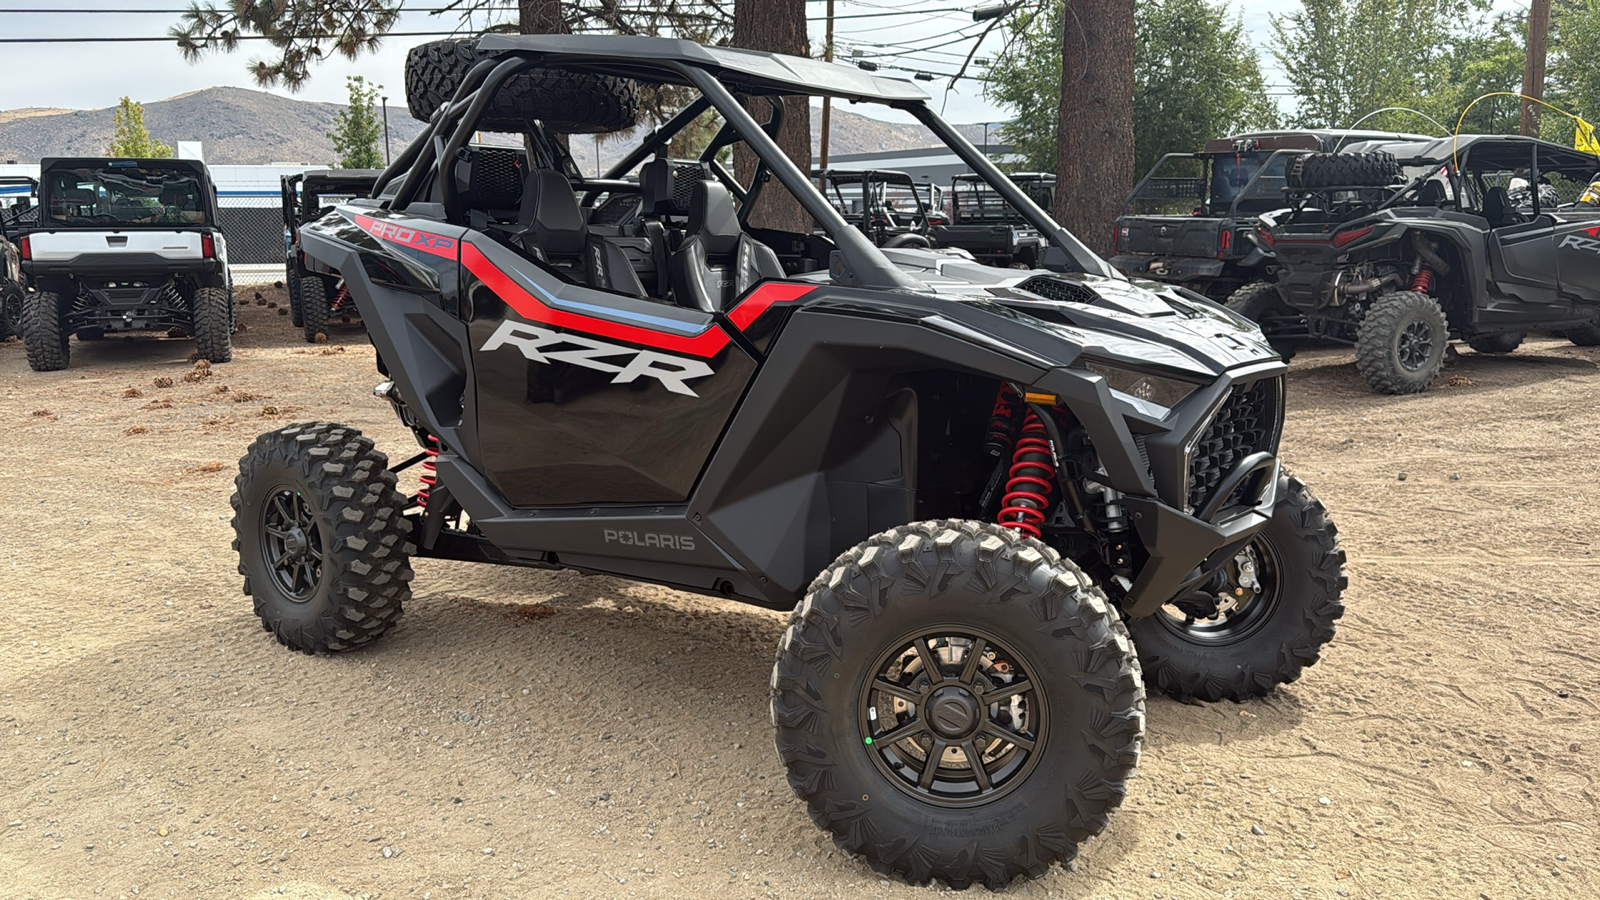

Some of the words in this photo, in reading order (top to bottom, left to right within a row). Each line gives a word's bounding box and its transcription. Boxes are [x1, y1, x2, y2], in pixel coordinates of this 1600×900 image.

[370, 220, 415, 243] PRO
[414, 233, 454, 249] XP
[1558, 234, 1600, 254] RZ
[479, 319, 715, 398] RZR
[603, 529, 695, 551] POLARIS
